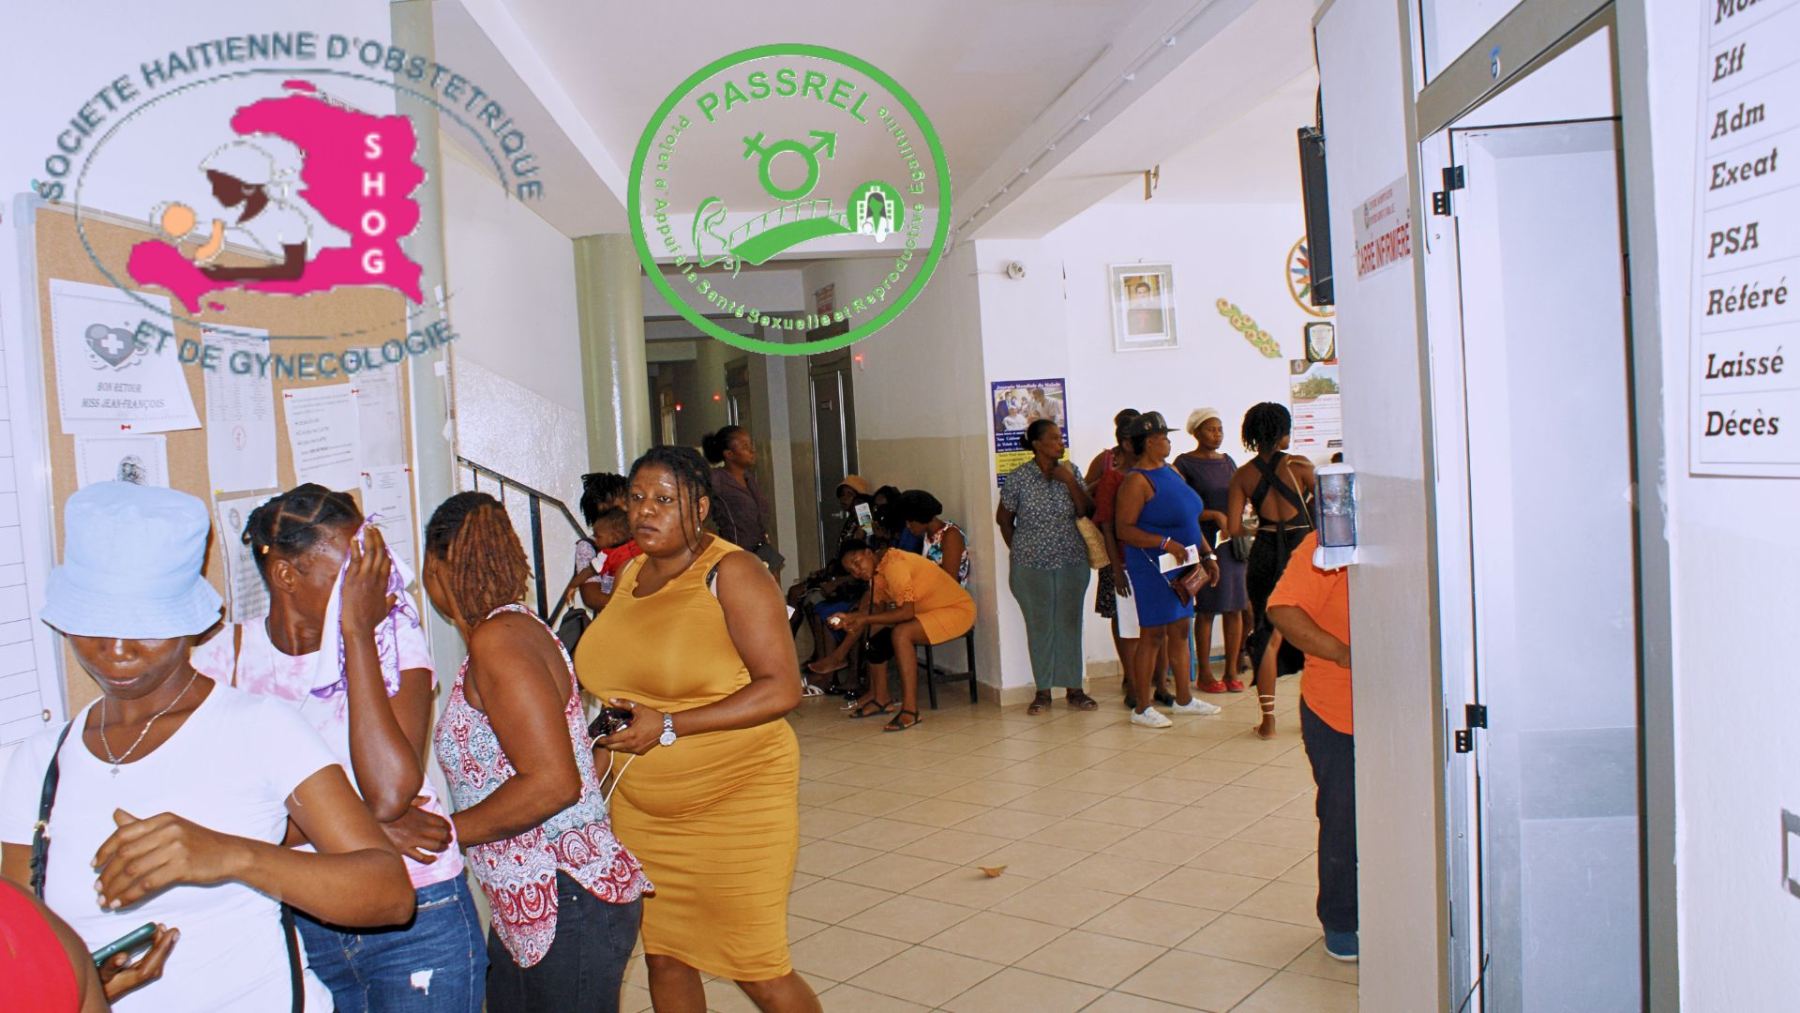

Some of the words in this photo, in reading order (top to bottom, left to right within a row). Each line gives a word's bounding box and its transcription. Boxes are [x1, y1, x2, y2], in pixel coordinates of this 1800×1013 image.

[1712, 42, 1746, 83] Eff
[1710, 102, 1765, 140] Adm
[1709, 147, 1778, 191] Exeat
[1707, 221, 1759, 259] PSA
[1706, 275, 1787, 316] Référé
[1705, 345, 1784, 380] Laissé
[1704, 408, 1779, 437] Décès
